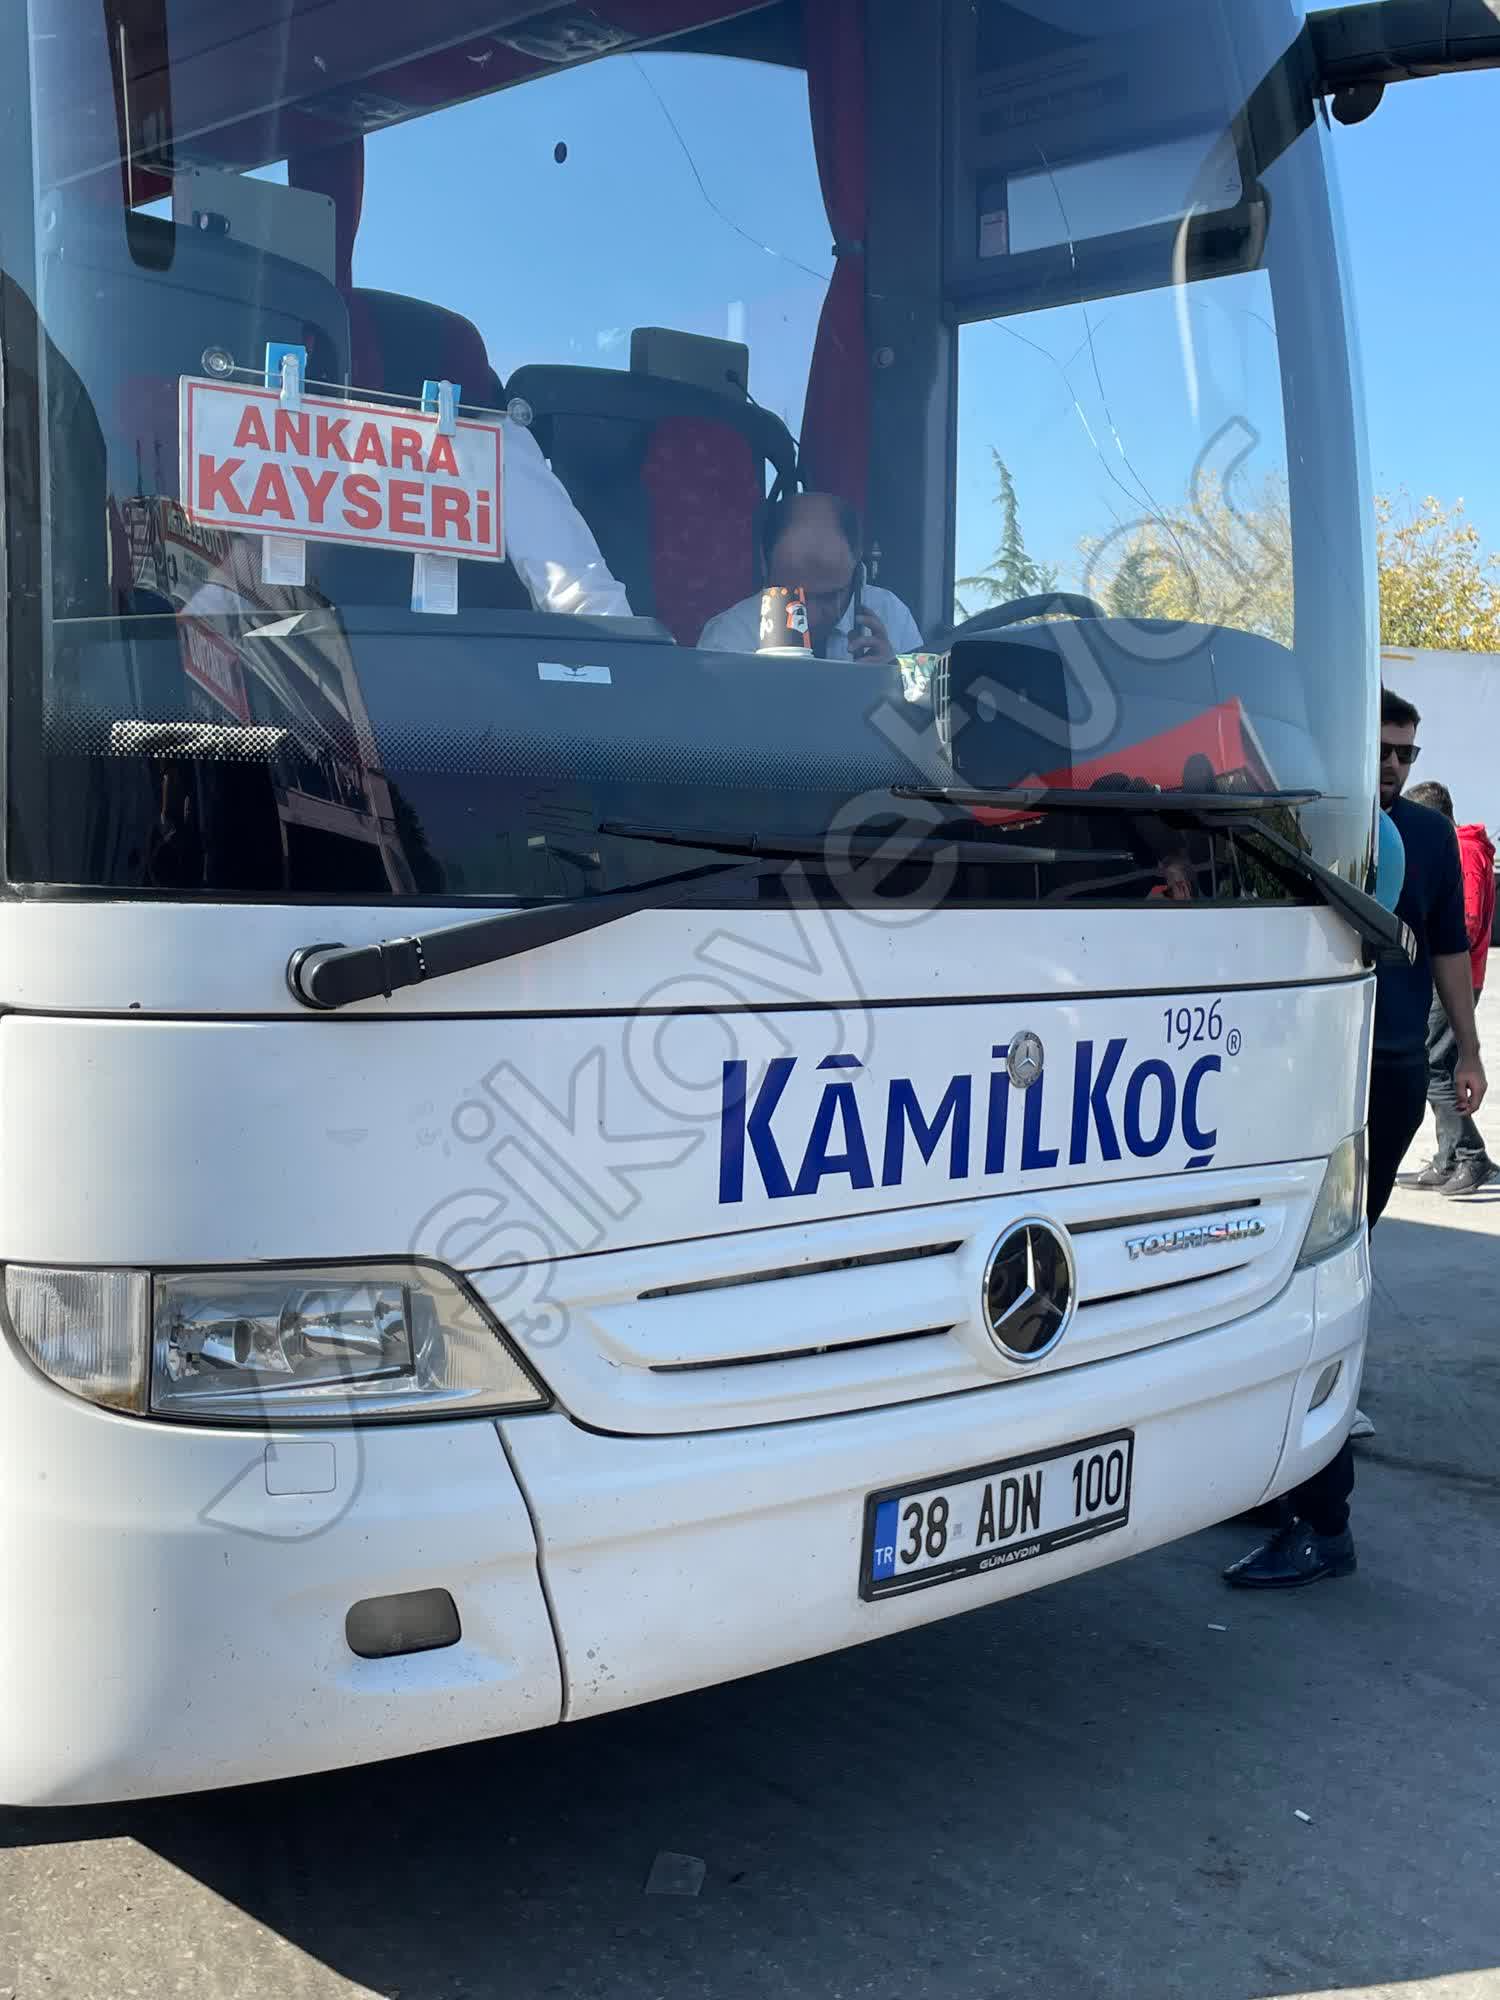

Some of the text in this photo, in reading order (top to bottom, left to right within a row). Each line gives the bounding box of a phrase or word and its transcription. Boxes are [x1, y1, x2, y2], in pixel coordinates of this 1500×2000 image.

[233, 404, 460, 477] ANKARA
[1164, 998, 1222, 1051] 1926
[1125, 1218, 1266, 1261] TOURISMO
[900, 1449, 1124, 1565] 38 ADN 100
[874, 1546, 894, 1567] TR
[979, 1543, 1041, 1570] GÜNAYDIN
